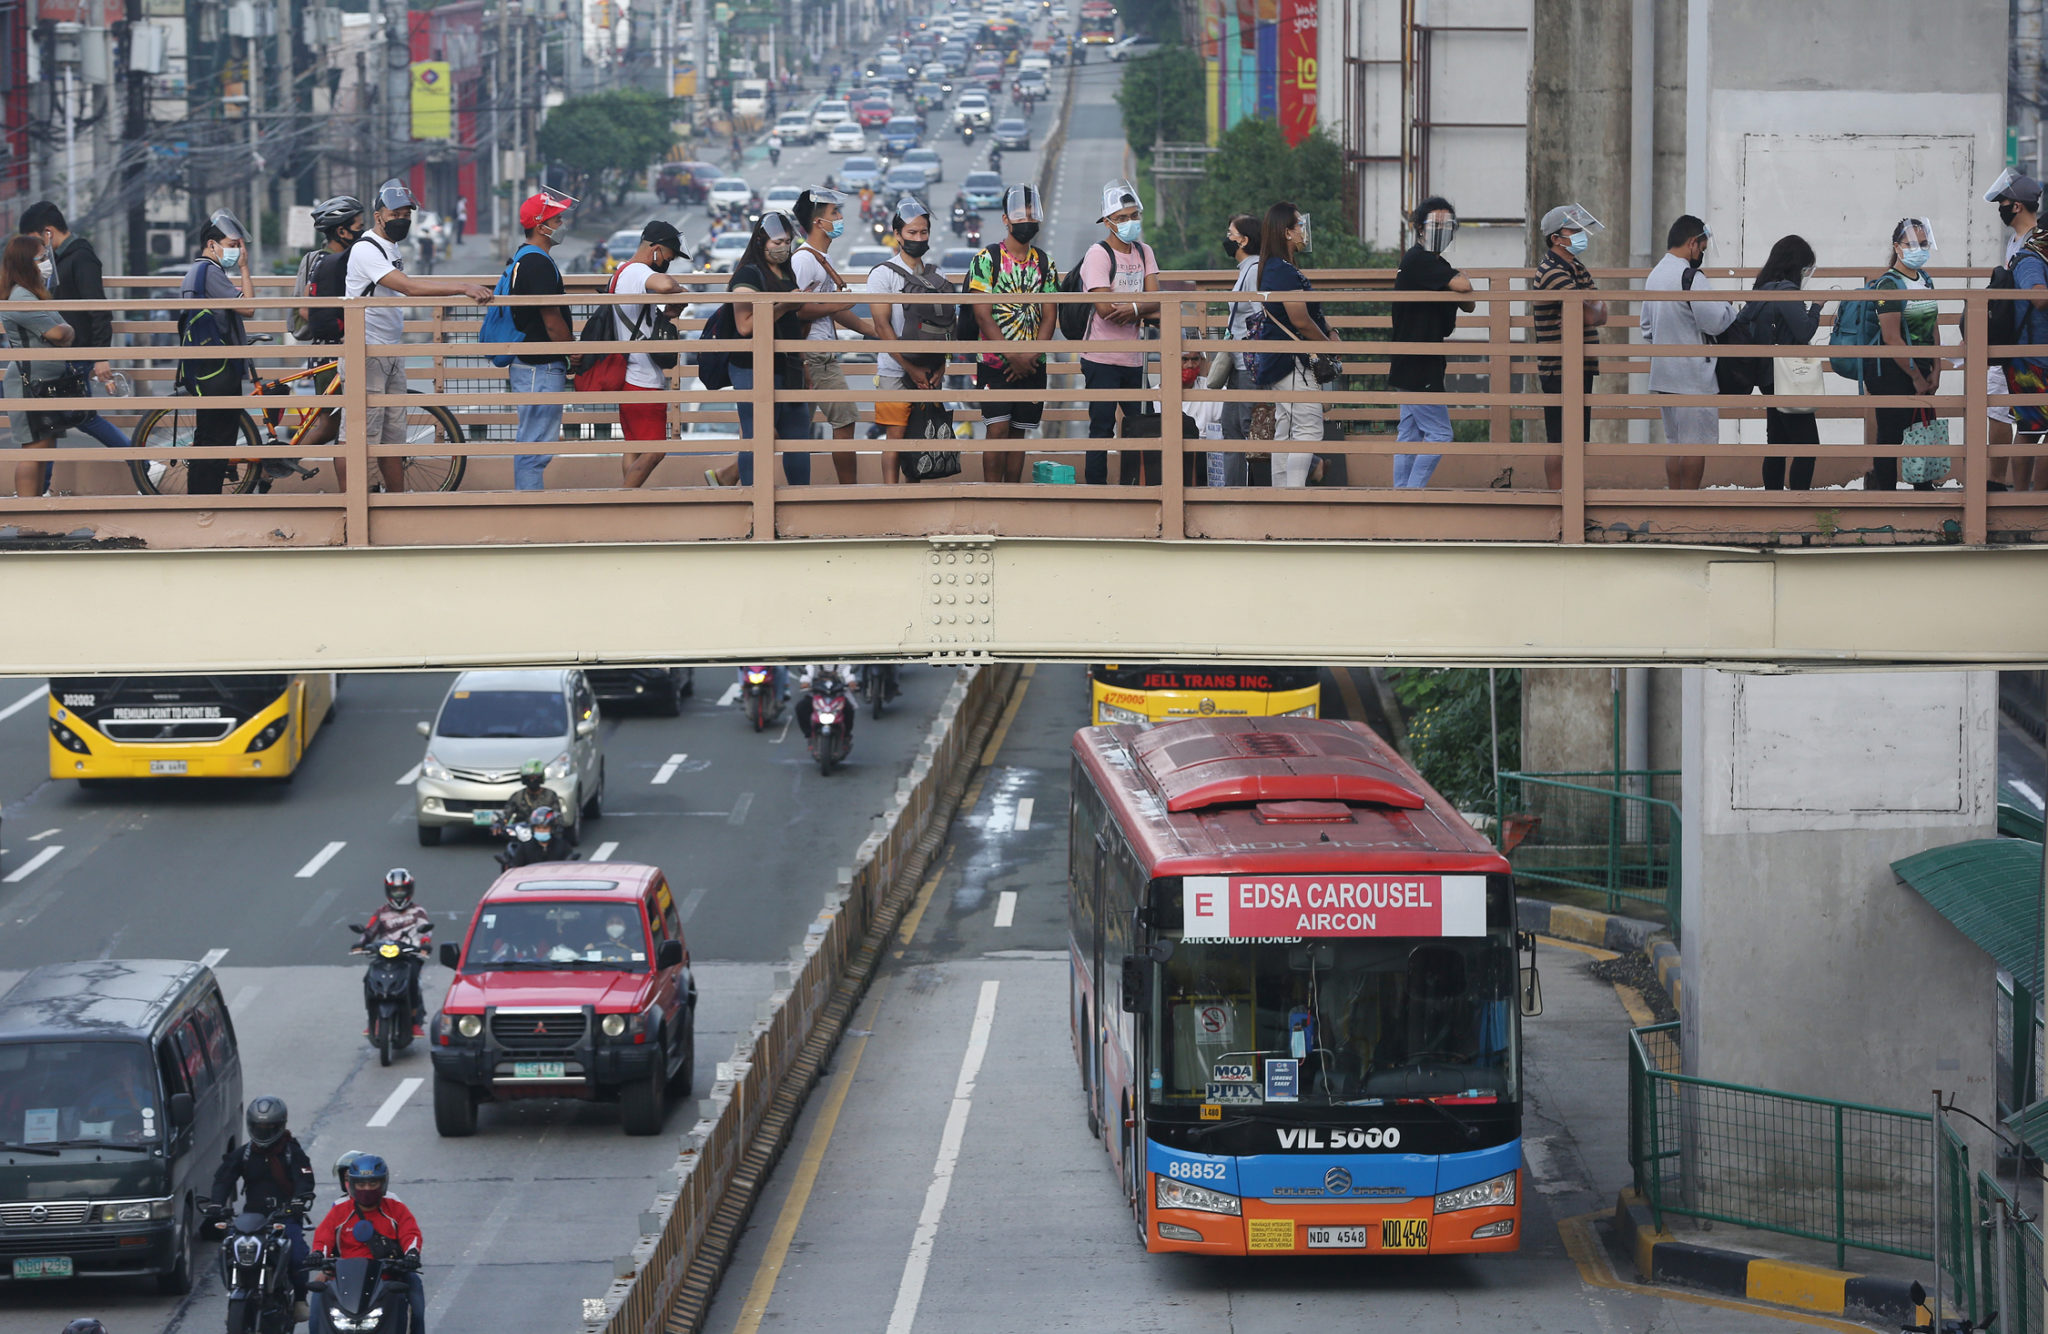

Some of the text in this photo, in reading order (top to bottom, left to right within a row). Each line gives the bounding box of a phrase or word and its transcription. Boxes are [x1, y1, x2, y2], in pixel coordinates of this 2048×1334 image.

[1143, 674, 1273, 689] JELL TRANS INC.
[113, 706, 221, 720] PREMIUM POINT TO POINT BUS
[1239, 882, 1433, 909] EDSA CAROUSEL
[1195, 892, 1214, 917] E
[1296, 913, 1376, 931] AIRCON
[1215, 1065, 1252, 1077] MOA
[1207, 1084, 1262, 1099] PITX
[1276, 1127, 1400, 1149] VIL 5000
[1169, 1161, 1226, 1180] 88852
[1272, 1186, 1407, 1195] GOLDEN DRAGON
[1309, 1229, 1364, 1243] NDQ 4548
[1381, 1219, 1428, 1249] NDQ 4548
